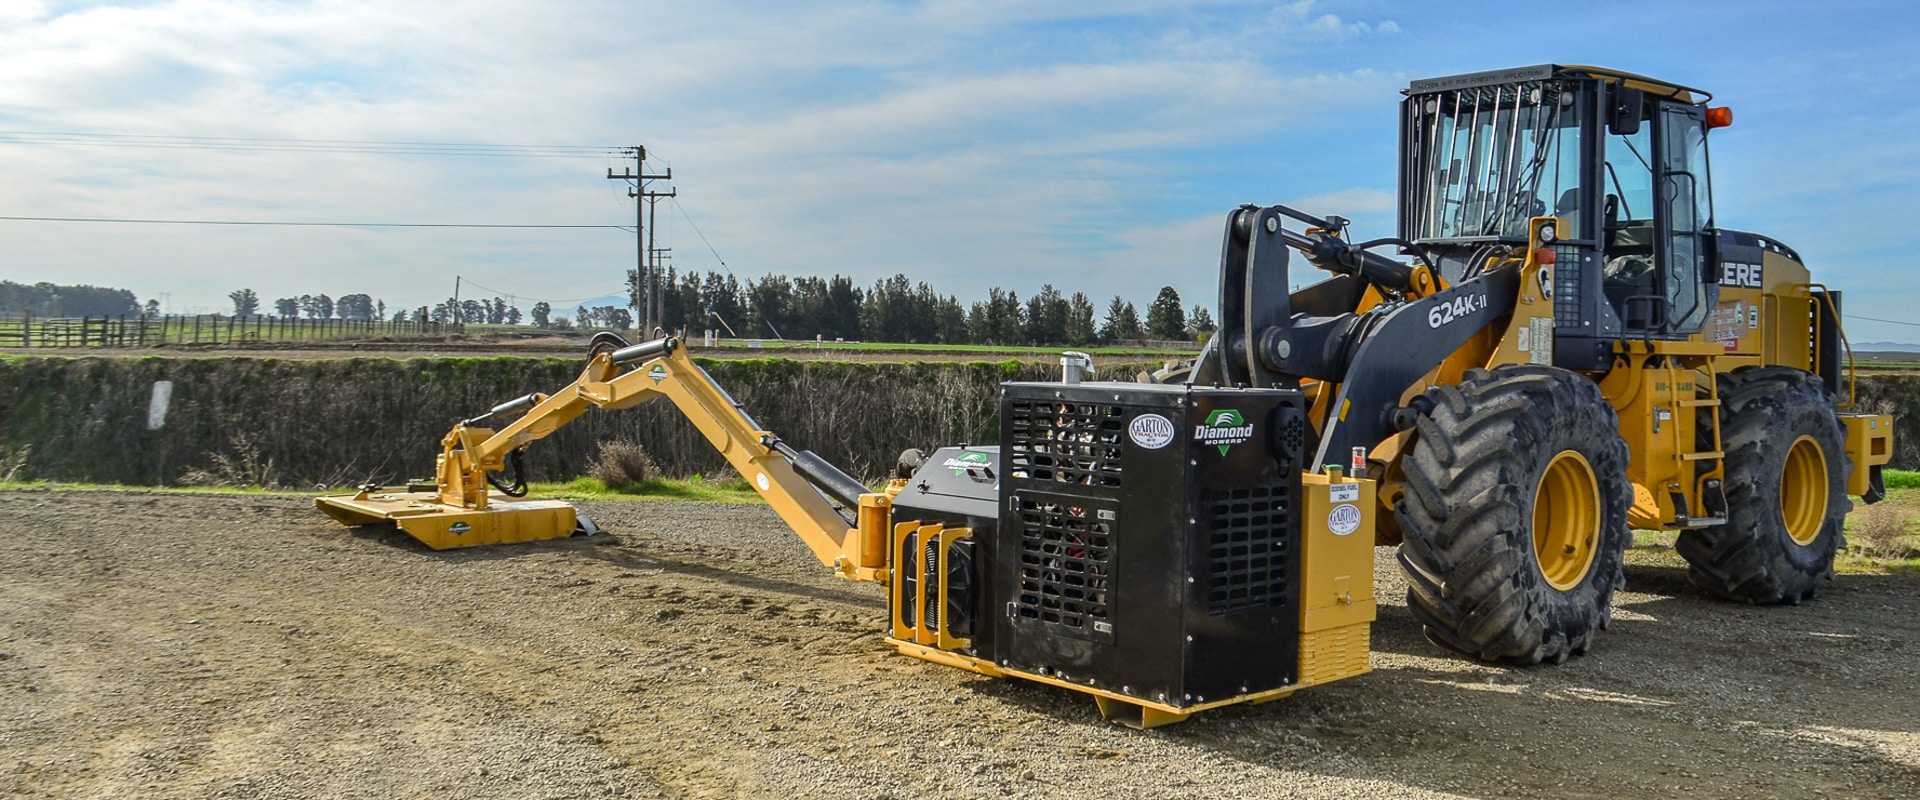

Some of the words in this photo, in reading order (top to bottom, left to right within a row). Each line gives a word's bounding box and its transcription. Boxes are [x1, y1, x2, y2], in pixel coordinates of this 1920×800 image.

[1719, 262, 1762, 287] ERE
[1428, 293, 1487, 329] 624K-II
[1132, 419, 1169, 433] GARTON
[1194, 424, 1253, 439] Diamond
[943, 458, 992, 468] Diamond
